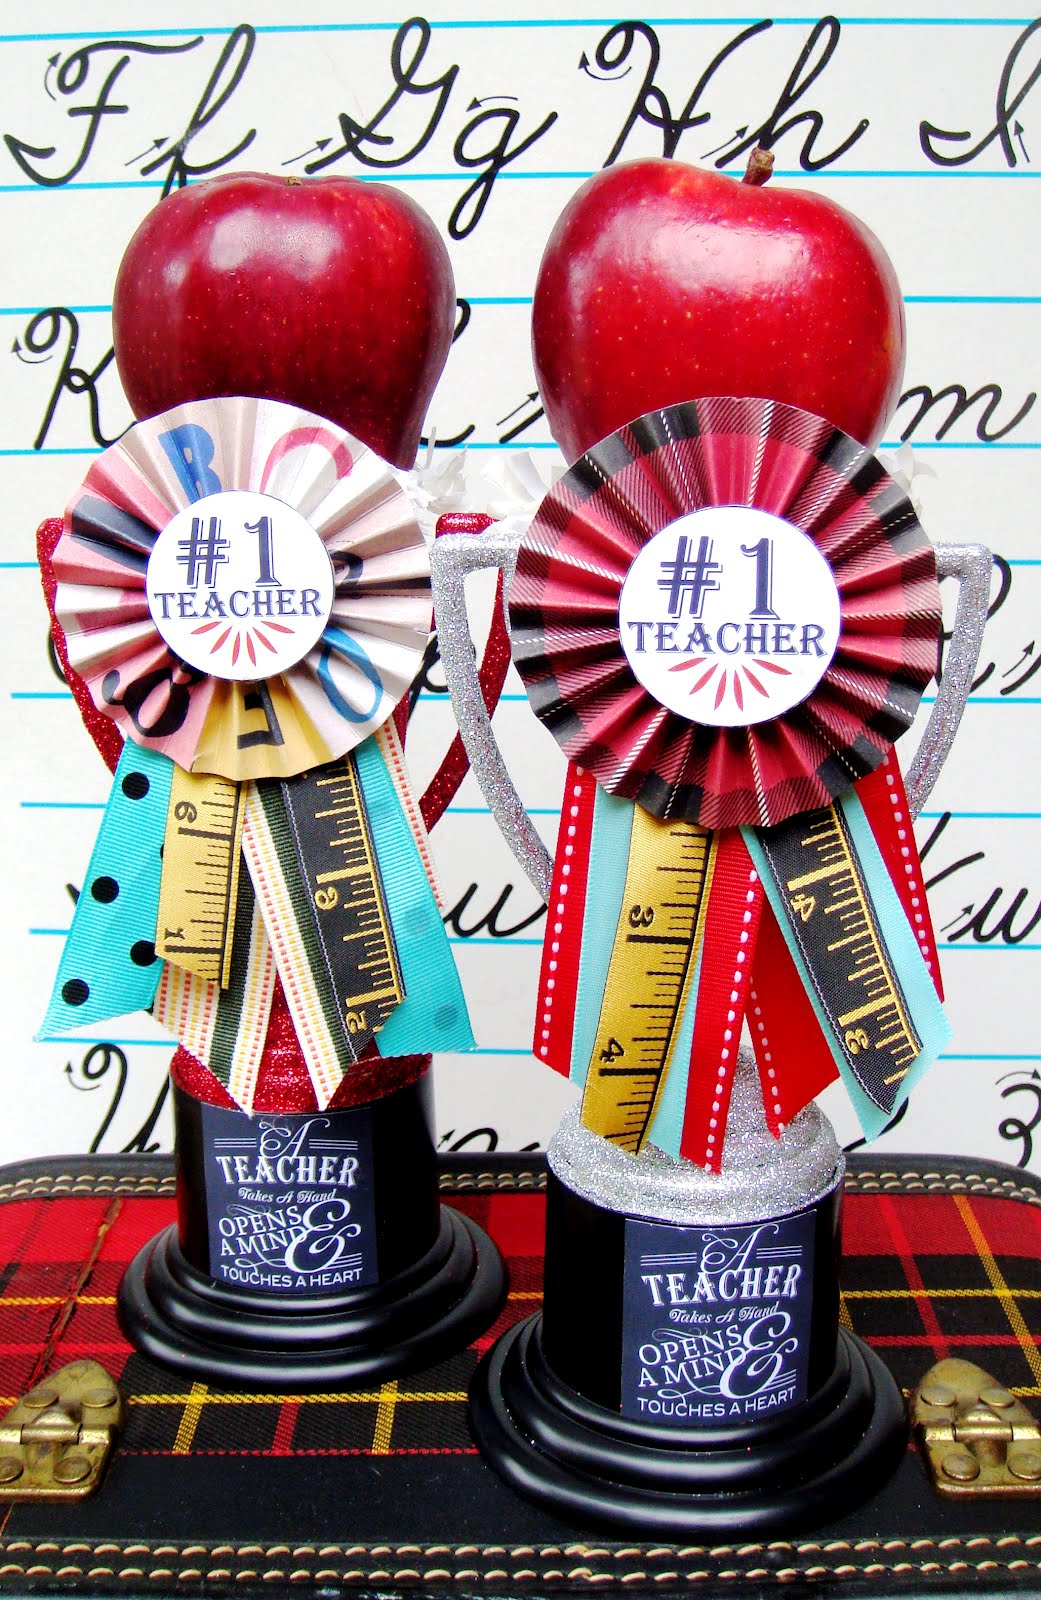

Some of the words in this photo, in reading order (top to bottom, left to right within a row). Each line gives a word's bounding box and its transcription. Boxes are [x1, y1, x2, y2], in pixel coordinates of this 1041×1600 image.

[176, 516, 282, 589] #1
[657, 535, 780, 620] #1
[154, 588, 324, 620] TEACHER
[627, 621, 828, 658] TEACHER
[259, 1116, 331, 1159] A
[215, 1155, 360, 1187] TEACHER
[238, 1187, 273, 1203] Takes
[276, 1190, 293, 1204] A
[296, 1188, 337, 1204] Hand
[218, 1205, 302, 1237] OPENS
[220, 1238, 235, 1257] A
[236, 1225, 307, 1255] MIND
[700, 1222, 780, 1274] A
[220, 1264, 292, 1288] TOUCHES
[295, 1275, 307, 1288] A
[309, 1267, 363, 1287] HEART
[640, 1263, 801, 1307] TEACHER
[669, 1308, 711, 1324] Takes
[715, 1308, 735, 1324] A
[738, 1300, 780, 1321] Hand
[638, 1324, 743, 1365] OPENS
[638, 1367, 658, 1388] A
[661, 1346, 746, 1386] MIND
[637, 1397, 726, 1417] TOUCHES
[729, 1401, 743, 1416] A
[745, 1386, 797, 1413] HEART
